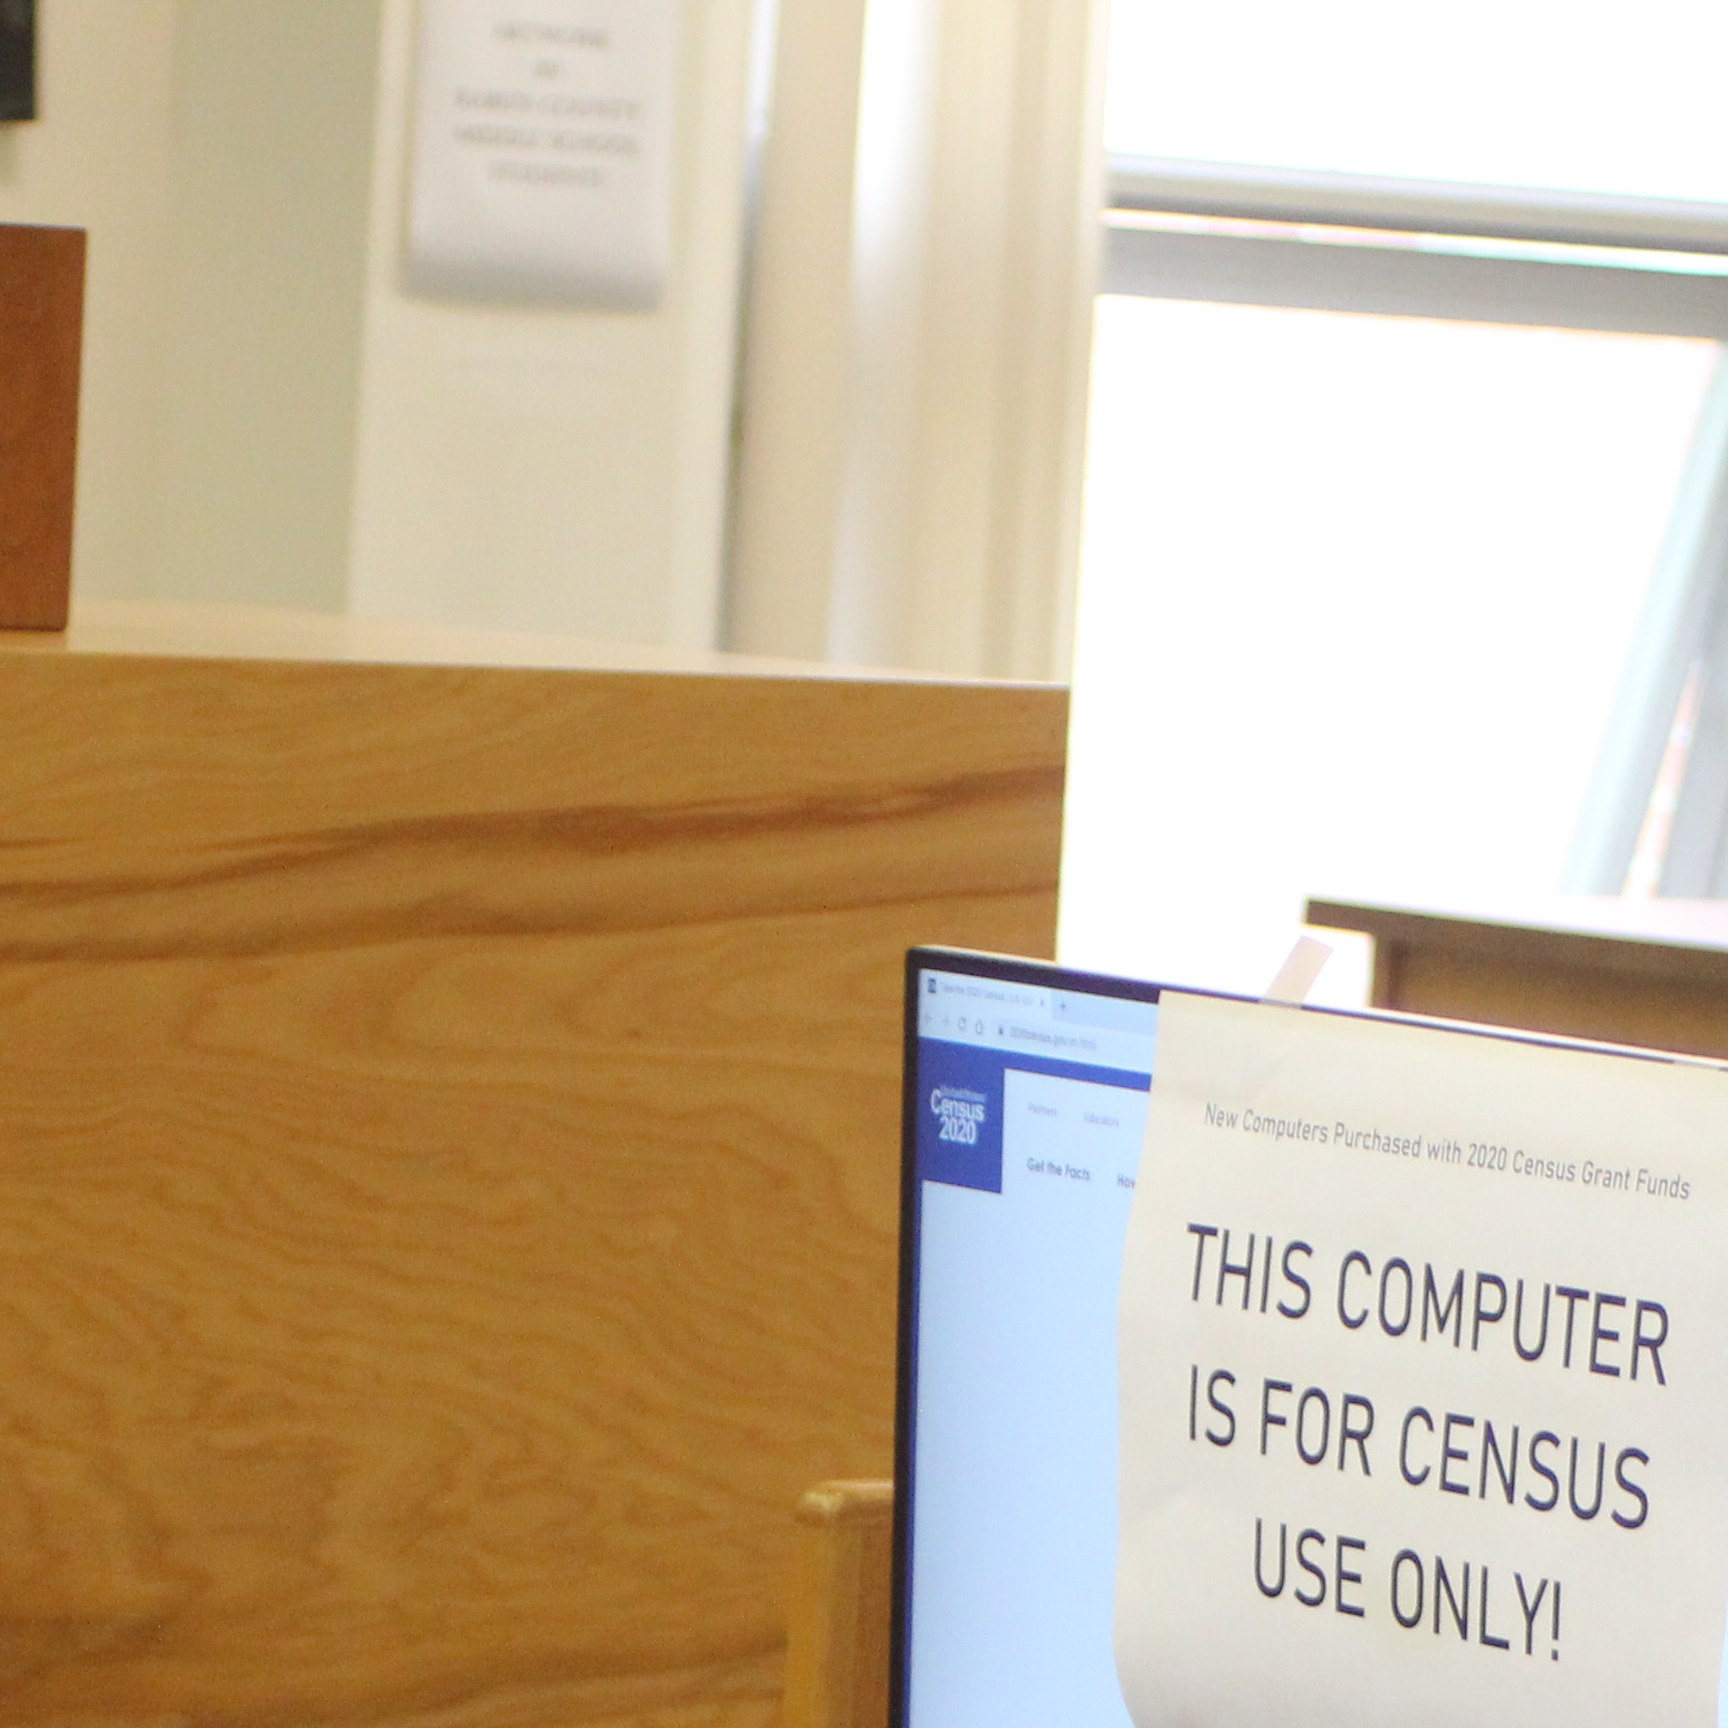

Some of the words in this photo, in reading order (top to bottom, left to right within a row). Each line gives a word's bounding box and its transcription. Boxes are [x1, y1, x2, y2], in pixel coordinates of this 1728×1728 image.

[931, 1089, 986, 1123] Census
[939, 1115, 978, 1145] 2020
[1204, 1101, 1239, 1128] New
[1242, 1109, 1329, 1143] Computers
[1334, 1122, 1421, 1158] Purchased
[1426, 1138, 1462, 1164] with
[1467, 1142, 1507, 1171] 2020
[1512, 1150, 1576, 1182] Census
[1582, 1160, 1630, 1191] Grant
[1636, 1168, 1690, 1200] Funds
[1027, 1157, 1045, 1173] Get
[1046, 1160, 1063, 1176] the
[1065, 1164, 1090, 1181] Facts
[1186, 1221, 1314, 1320] THIS
[1337, 1249, 1669, 1386] COMPUTER
[1188, 1363, 1236, 1447] IS
[1259, 1377, 1375, 1477] FOR
[1399, 1405, 1650, 1530] CENSUS
[1254, 1517, 1366, 1618] USE
[1390, 1547, 1562, 1662] ONLY!
